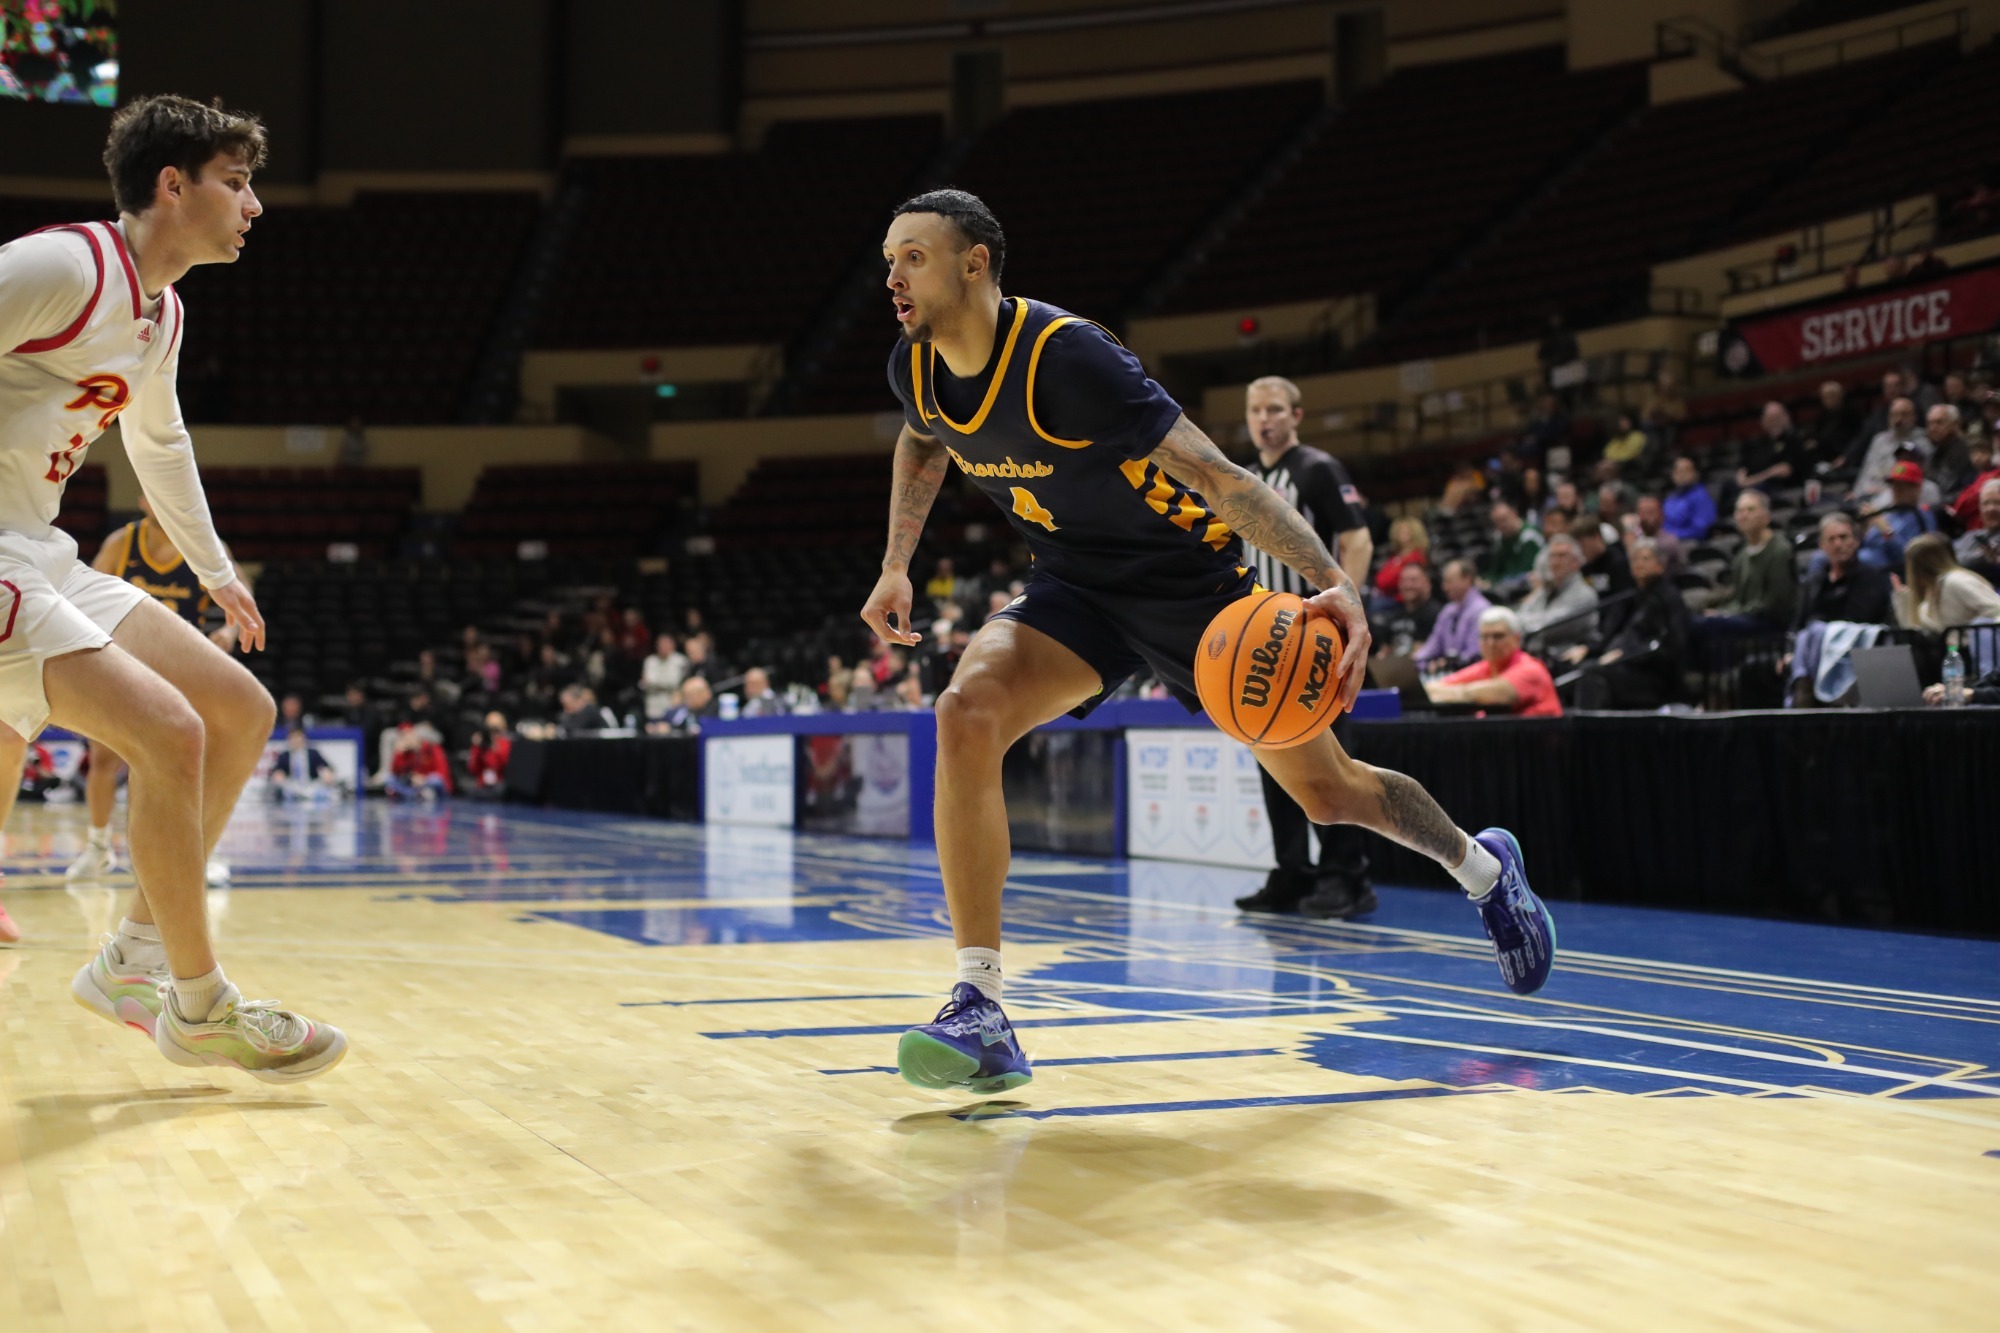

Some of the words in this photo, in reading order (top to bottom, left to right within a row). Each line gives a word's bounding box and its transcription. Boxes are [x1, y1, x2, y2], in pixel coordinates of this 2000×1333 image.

[1802, 289, 1951, 361] SERVICE
[945, 445, 1054, 478] Bronchos
[1009, 486, 1062, 532] 4
[1241, 609, 1298, 708] Wilson
[1297, 633, 1333, 713] NCAA
